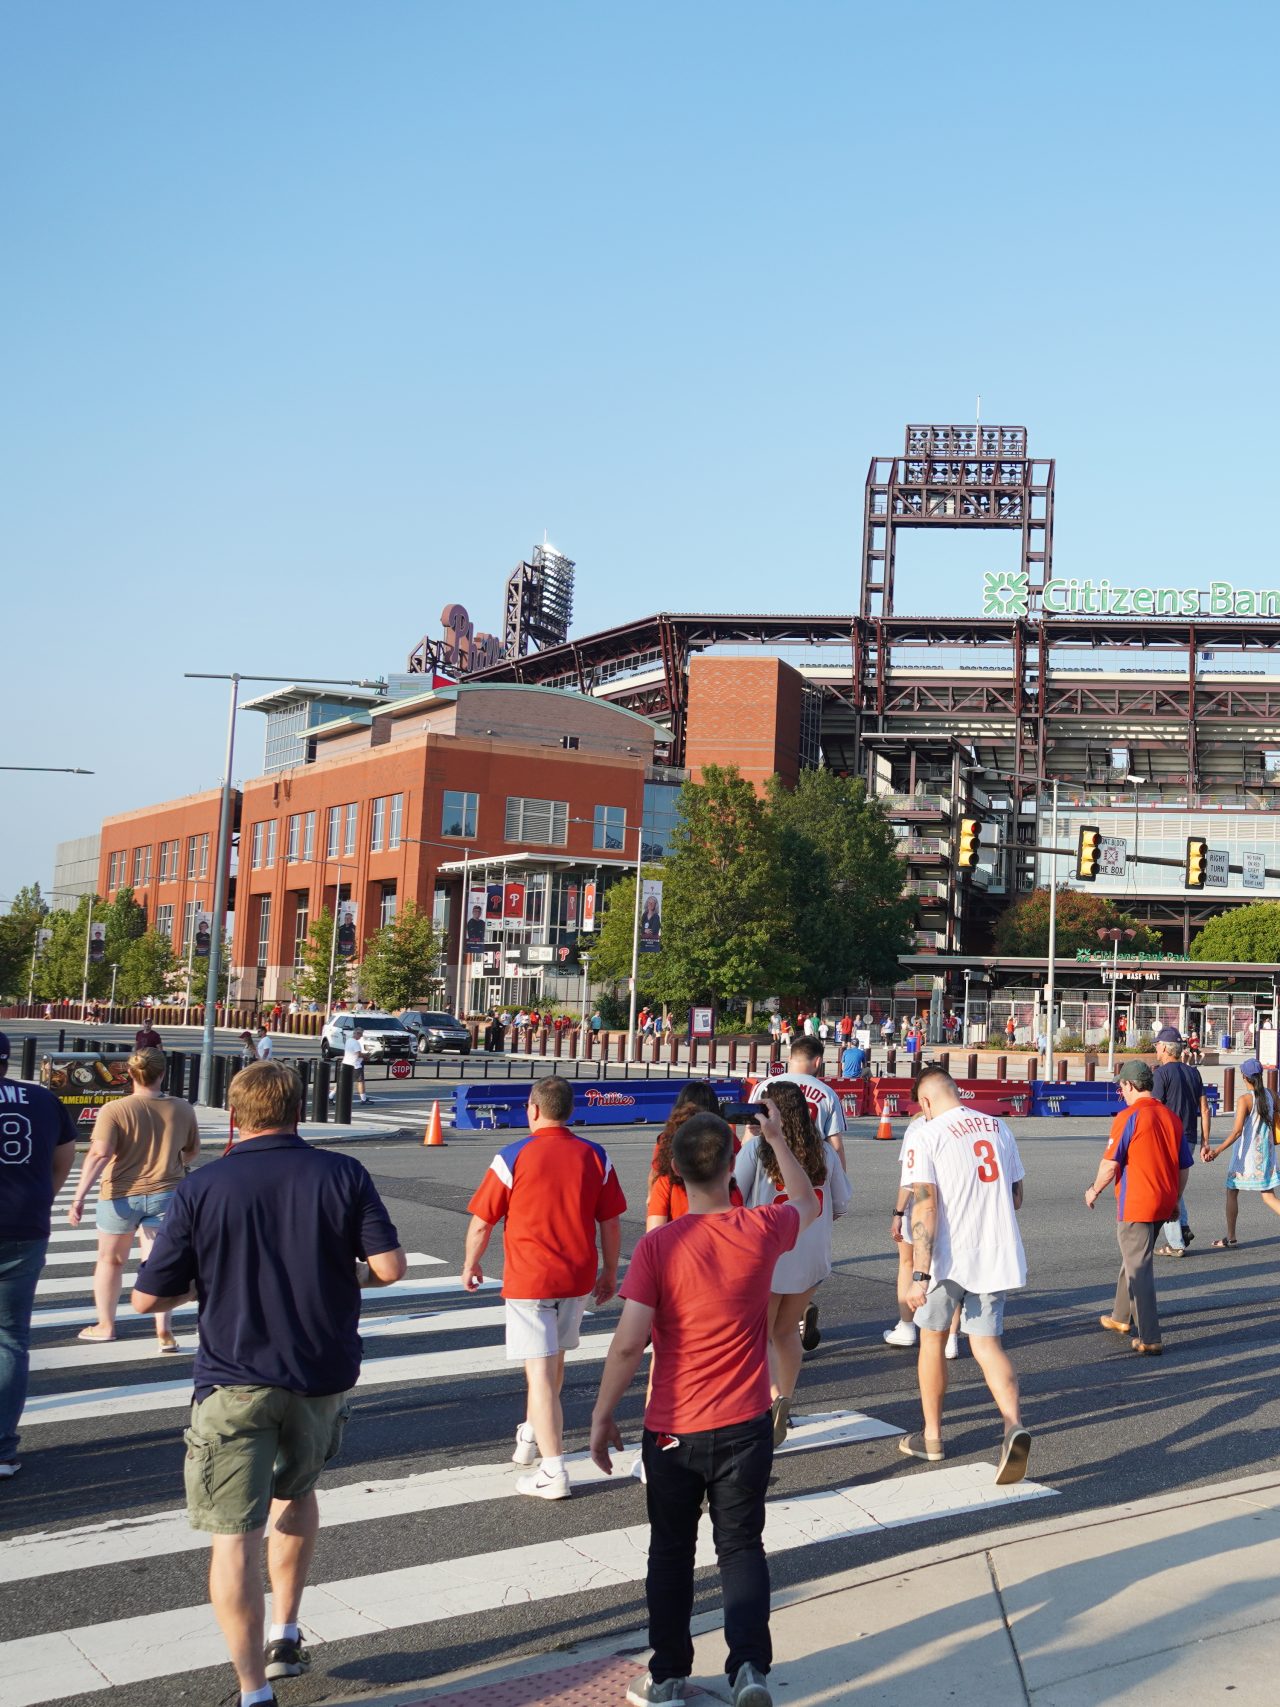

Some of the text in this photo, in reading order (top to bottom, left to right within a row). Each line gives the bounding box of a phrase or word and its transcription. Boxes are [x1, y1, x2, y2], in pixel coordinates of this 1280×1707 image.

[1043, 578, 1199, 614] Citizens
[1209, 854, 1226, 863] RIGHT
[1111, 866, 1124, 875] BOX
[1210, 864, 1225, 873] TURN
[1208, 874, 1226, 884] SIGNAL
[1093, 950, 1190, 962] Citiens Bank Park
[1105, 972, 1160, 981] THRD BASE GATE
[392, 1065, 411, 1074] STOP
[770, 1066, 785, 1074] STOP
[584, 1088, 636, 1107] Phillies
[800, 1084, 827, 1103] MIDT
[94, 1096, 105, 1105] OR
[78, 1107, 100, 1121] AC
[947, 1116, 1001, 1139] HARPER
[907, 1148, 915, 1169] 3
[973, 1139, 1000, 1183] 3
